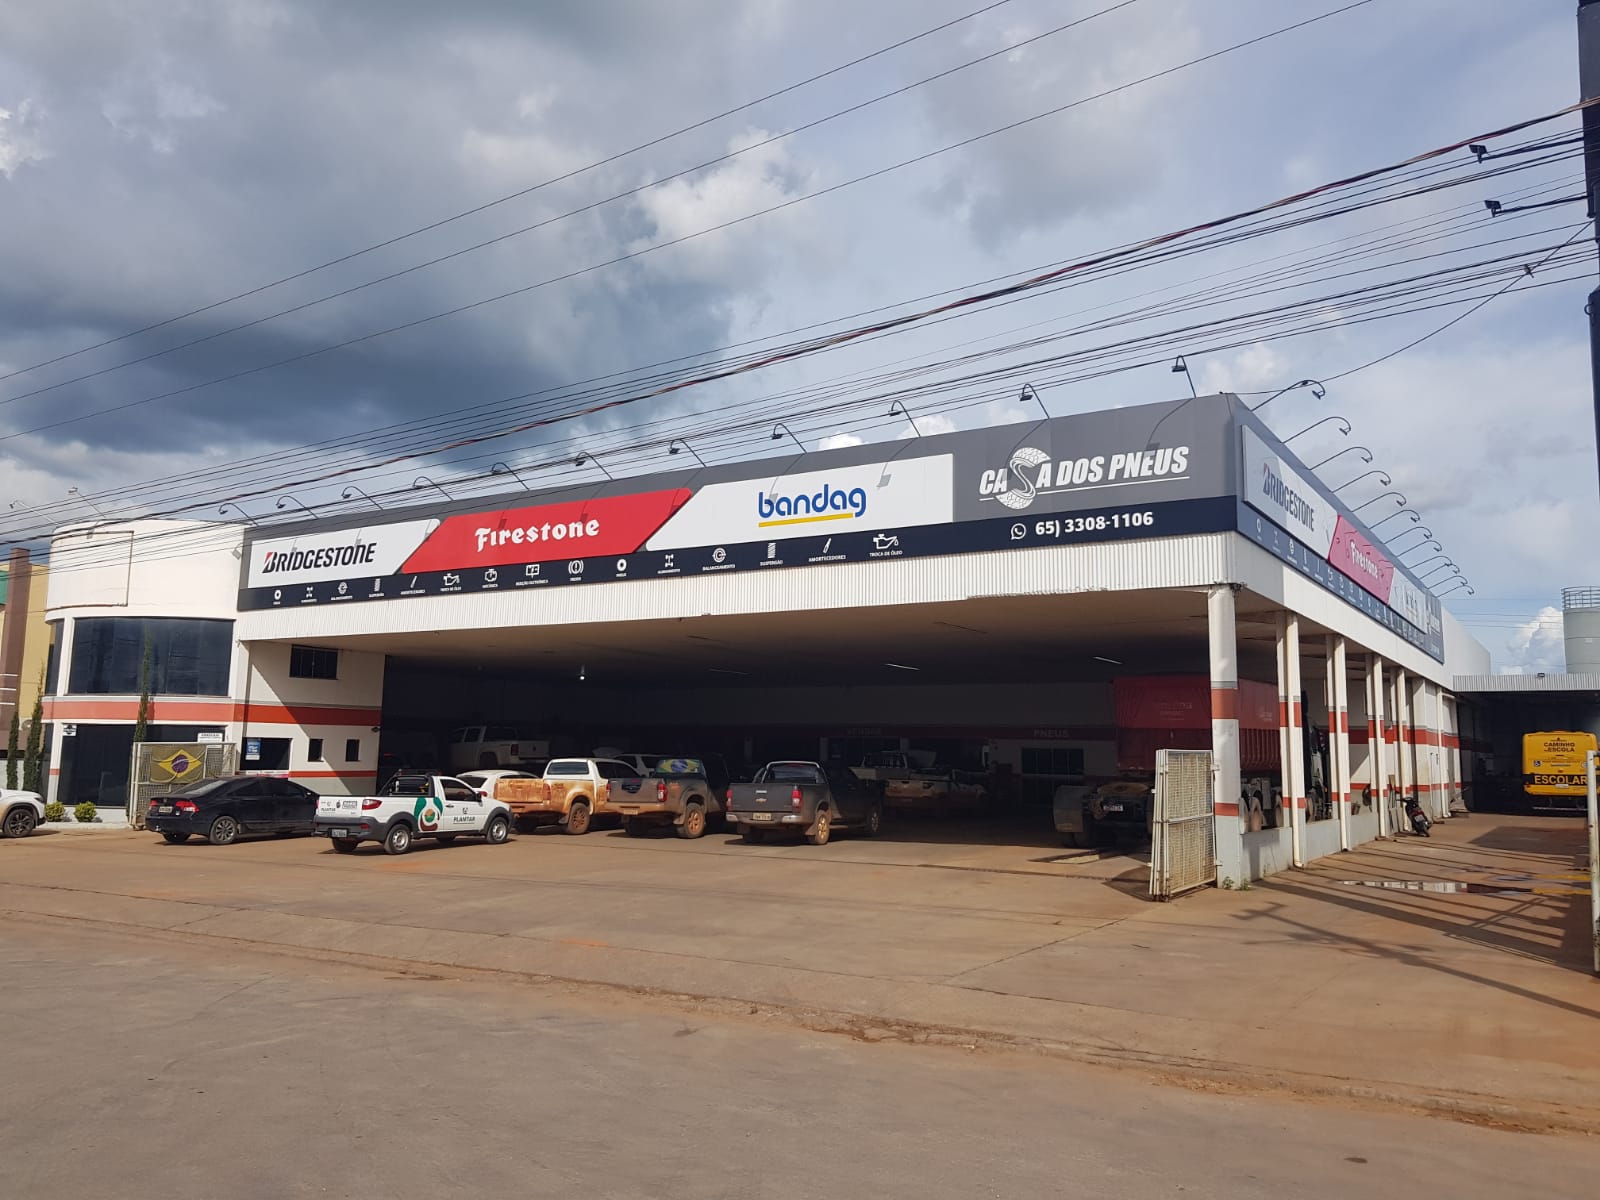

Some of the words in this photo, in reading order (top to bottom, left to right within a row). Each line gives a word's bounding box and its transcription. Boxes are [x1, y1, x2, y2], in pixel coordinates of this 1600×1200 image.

[978, 447, 1051, 510] CASA
[1055, 456, 1104, 486] DOS
[1107, 446, 1189, 481] PNEUS
[758, 484, 867, 518] bandag
[1262, 462, 1315, 533] BRIDGESTONE
[475, 519, 600, 552] Firestone
[1035, 520, 1060, 537] 65)
[1064, 511, 1154, 534] 3308-1106
[262, 543, 377, 574] BRIDGESTONE
[1534, 775, 1588, 785] ESCOLAR
